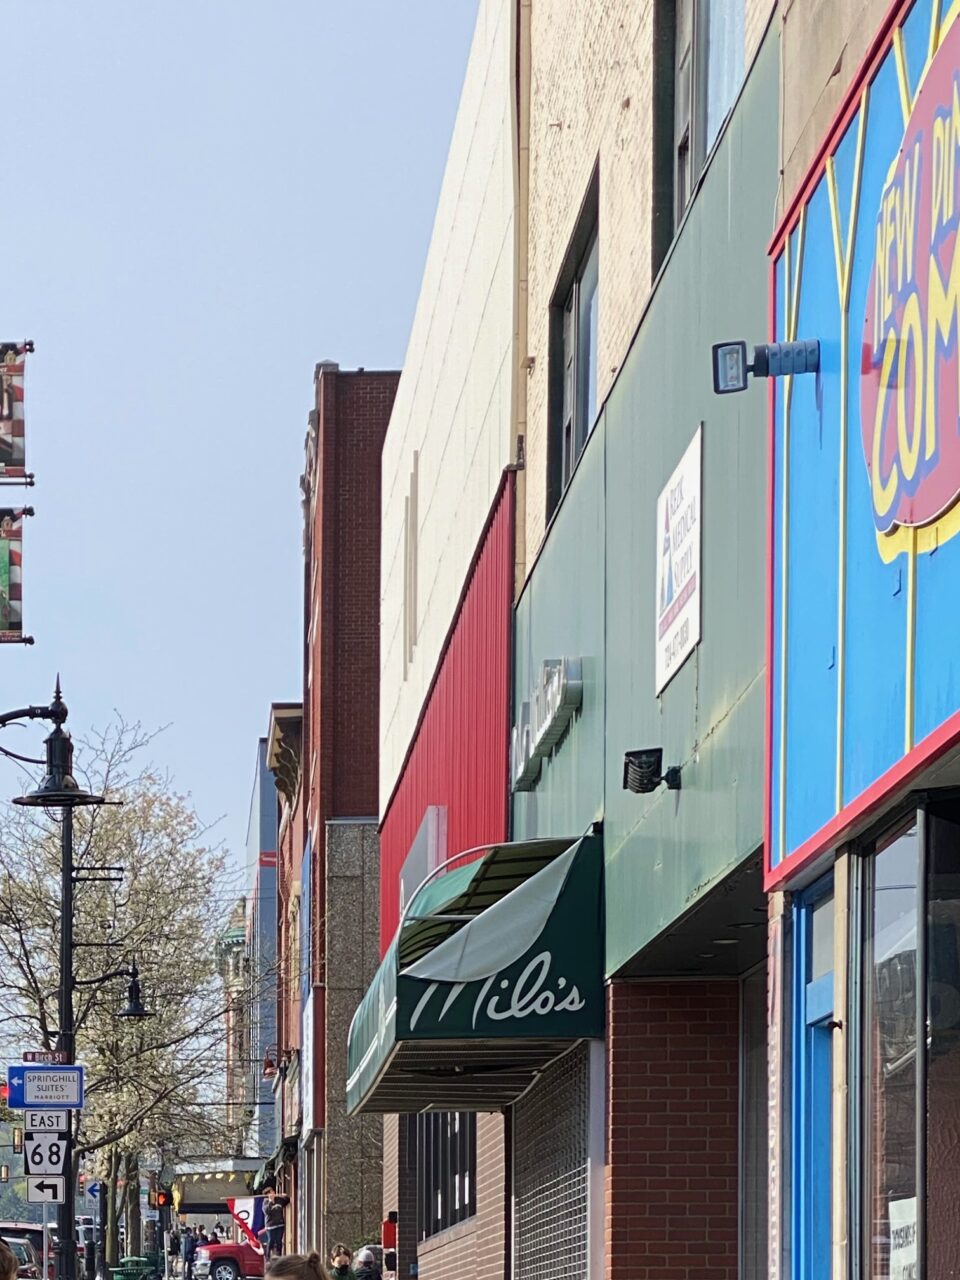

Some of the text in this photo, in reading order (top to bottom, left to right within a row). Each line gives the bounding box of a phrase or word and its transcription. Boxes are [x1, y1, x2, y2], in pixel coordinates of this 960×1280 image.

[874, 142, 919, 354] NEW
[673, 496, 696, 556] MEDICAL
[410, 951, 586, 1031] Milo's
[26, 1052, 63, 1062] W Birch St
[27, 1074, 76, 1083] SPRINGHILL
[36, 1084, 65, 1092] SUITES
[30, 1113, 61, 1128] EAST
[31, 1143, 61, 1165] 68
